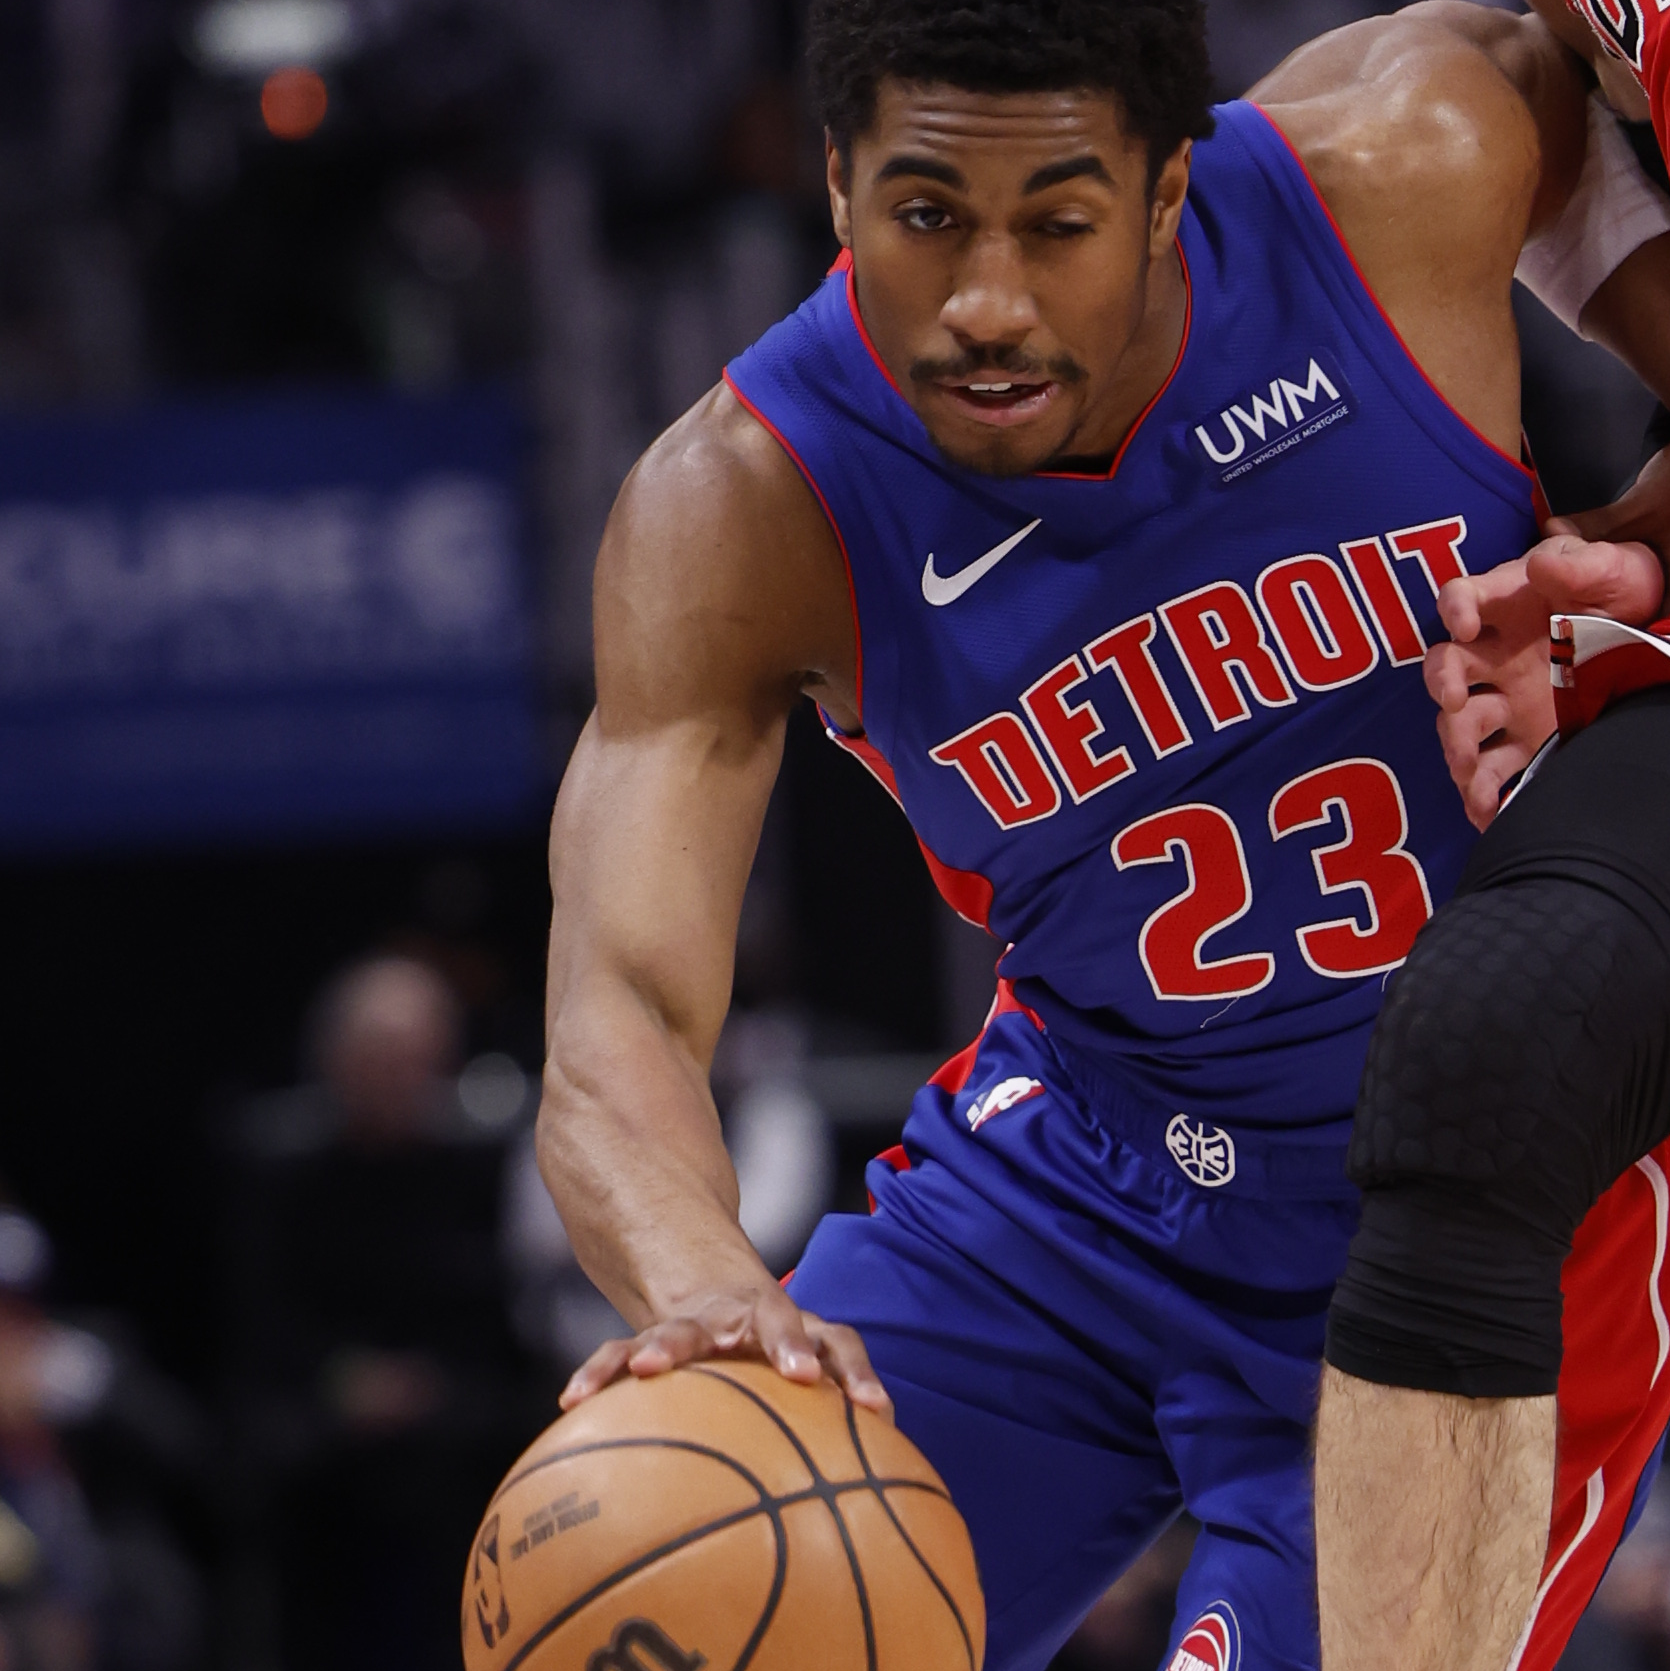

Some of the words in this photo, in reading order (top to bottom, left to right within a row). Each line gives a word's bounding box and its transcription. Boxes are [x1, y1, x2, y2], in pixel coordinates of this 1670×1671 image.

[1194, 357, 1341, 464] UWM
[1222, 462, 1253, 483] UNITED
[1252, 433, 1302, 466] WHOLESALE
[1302, 405, 1350, 438] MORTGAGE
[928, 515, 1468, 830] DETROIT
[1110, 756, 1434, 1001] 23
